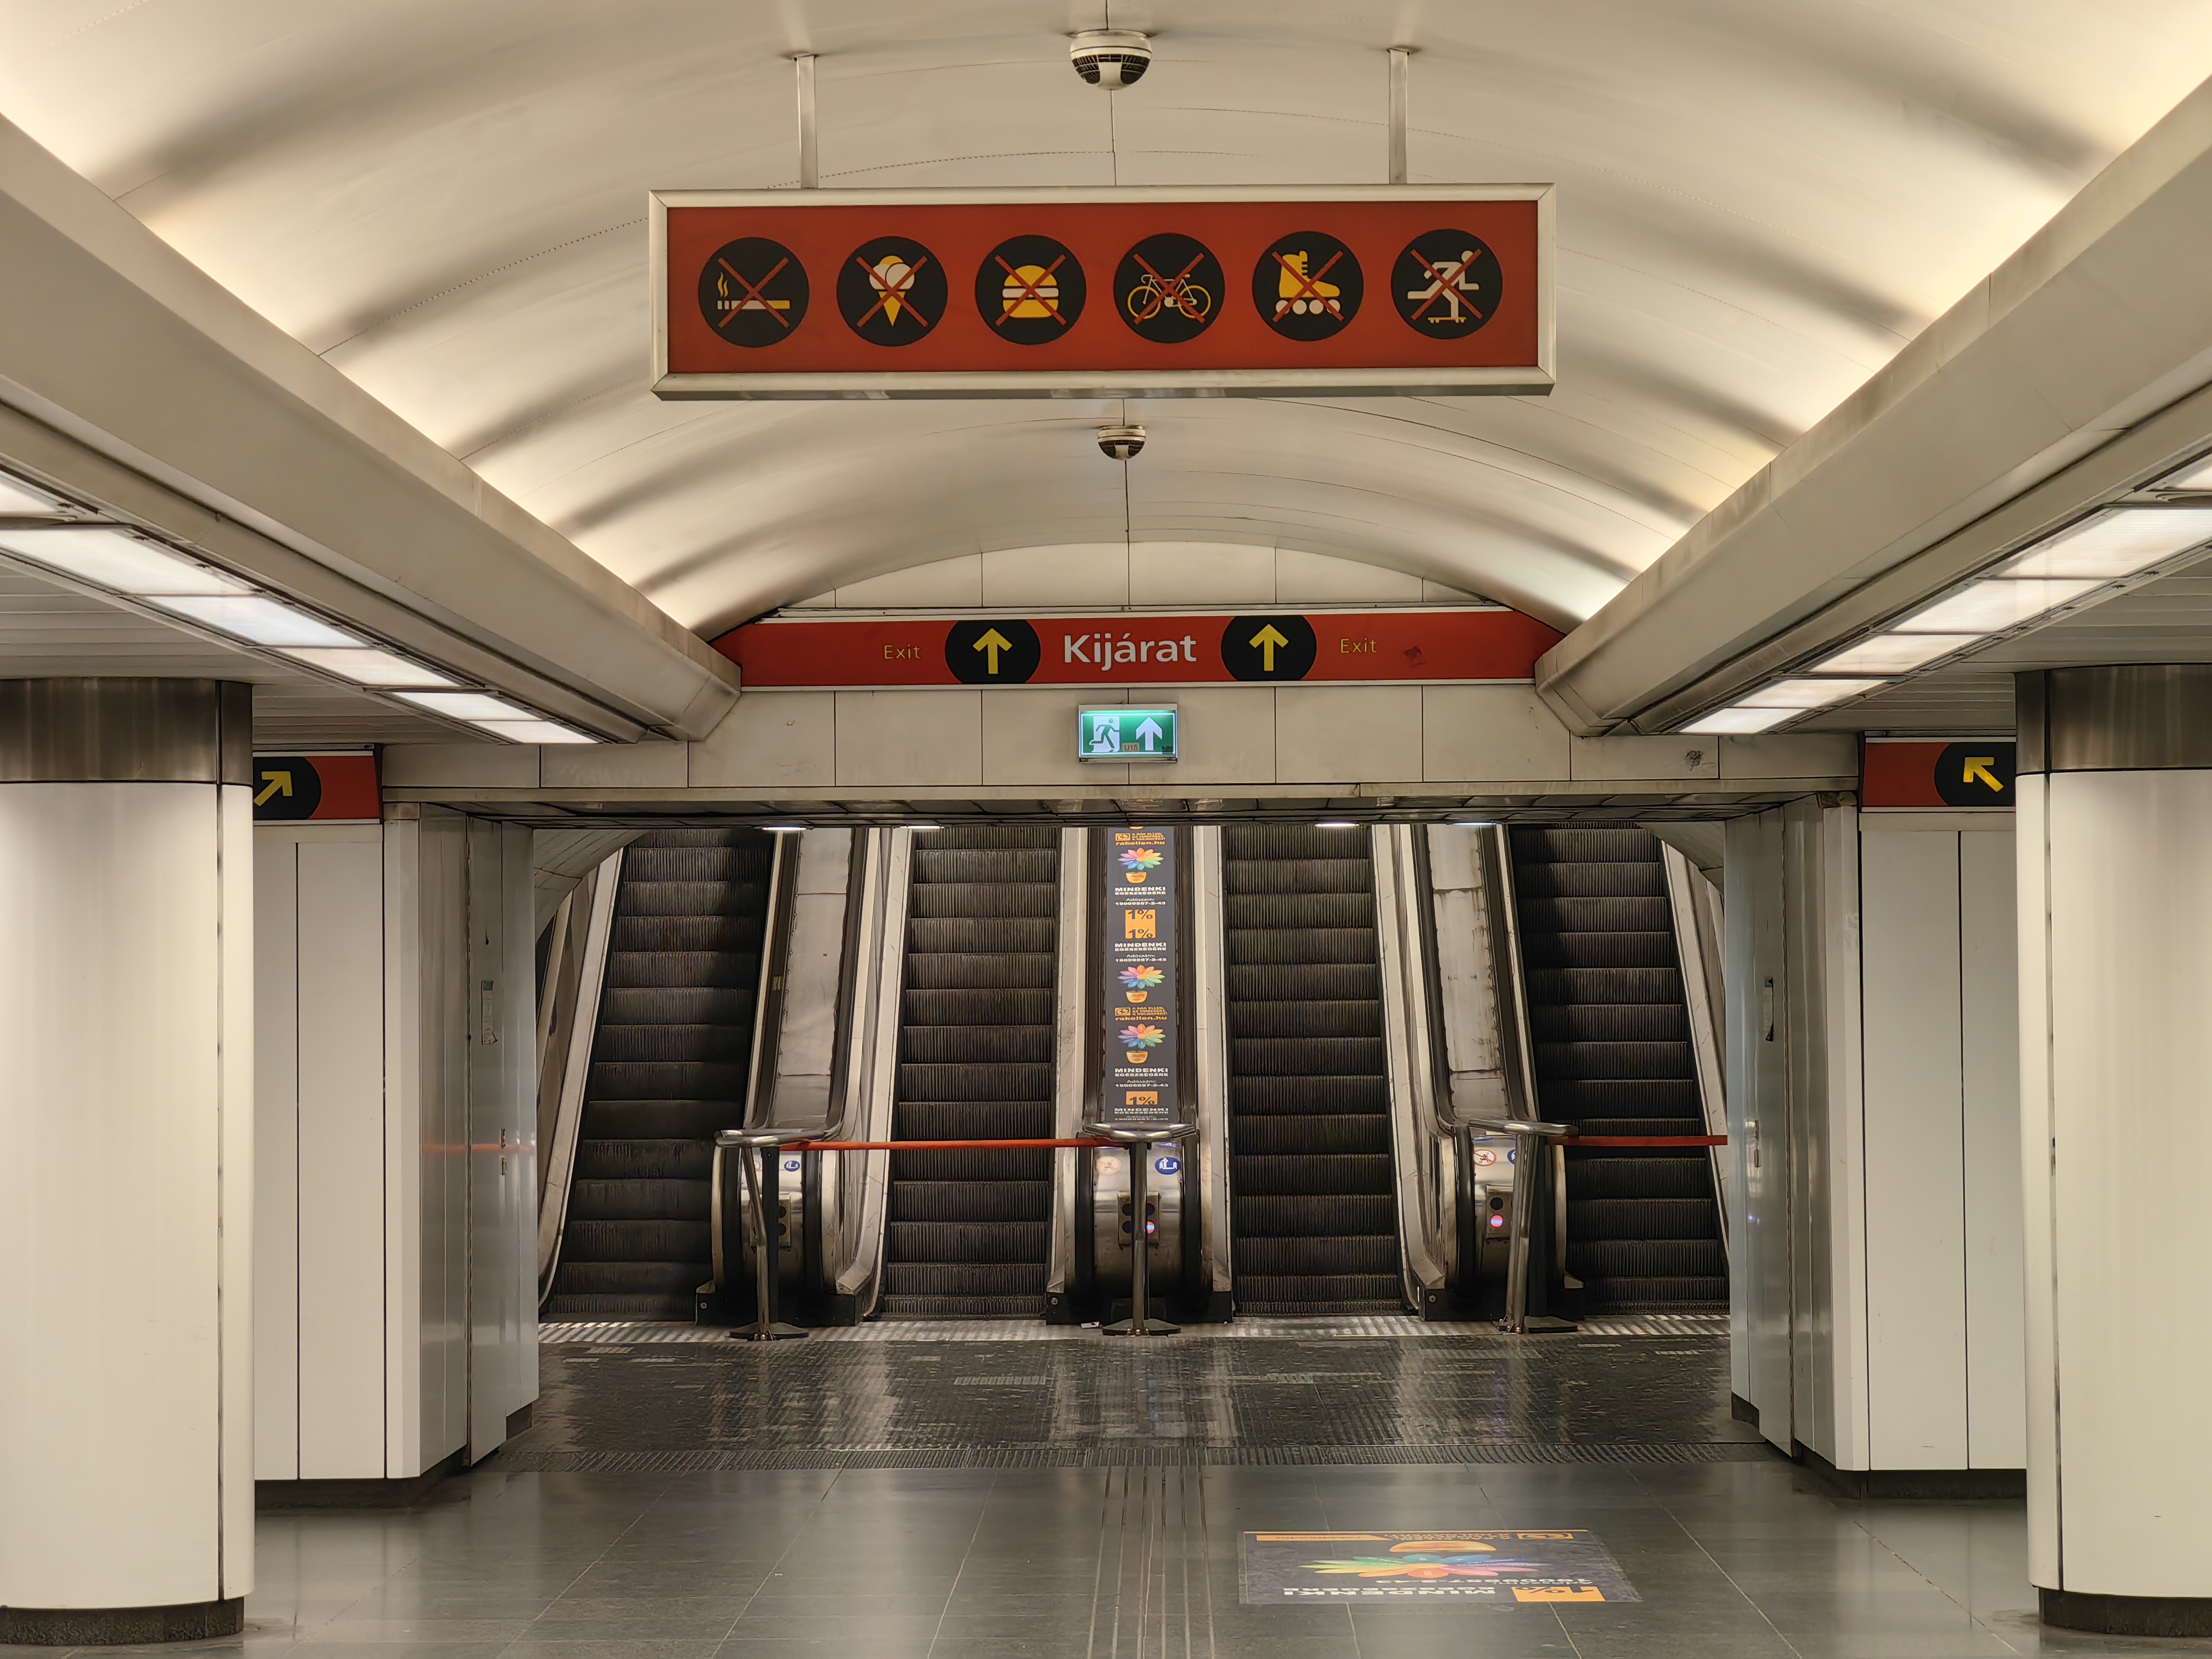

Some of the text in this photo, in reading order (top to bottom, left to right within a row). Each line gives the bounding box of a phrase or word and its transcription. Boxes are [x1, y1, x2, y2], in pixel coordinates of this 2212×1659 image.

[1341, 637, 1376, 653] Exit
[884, 644, 920, 659] Exit
[1064, 633, 1197, 671] Kijárat
[1128, 909, 1153, 920] 1%
[1128, 928, 1153, 939] 1%
[1129, 1096, 1155, 1105] 1%
[1514, 1586, 1595, 1594] 1%
